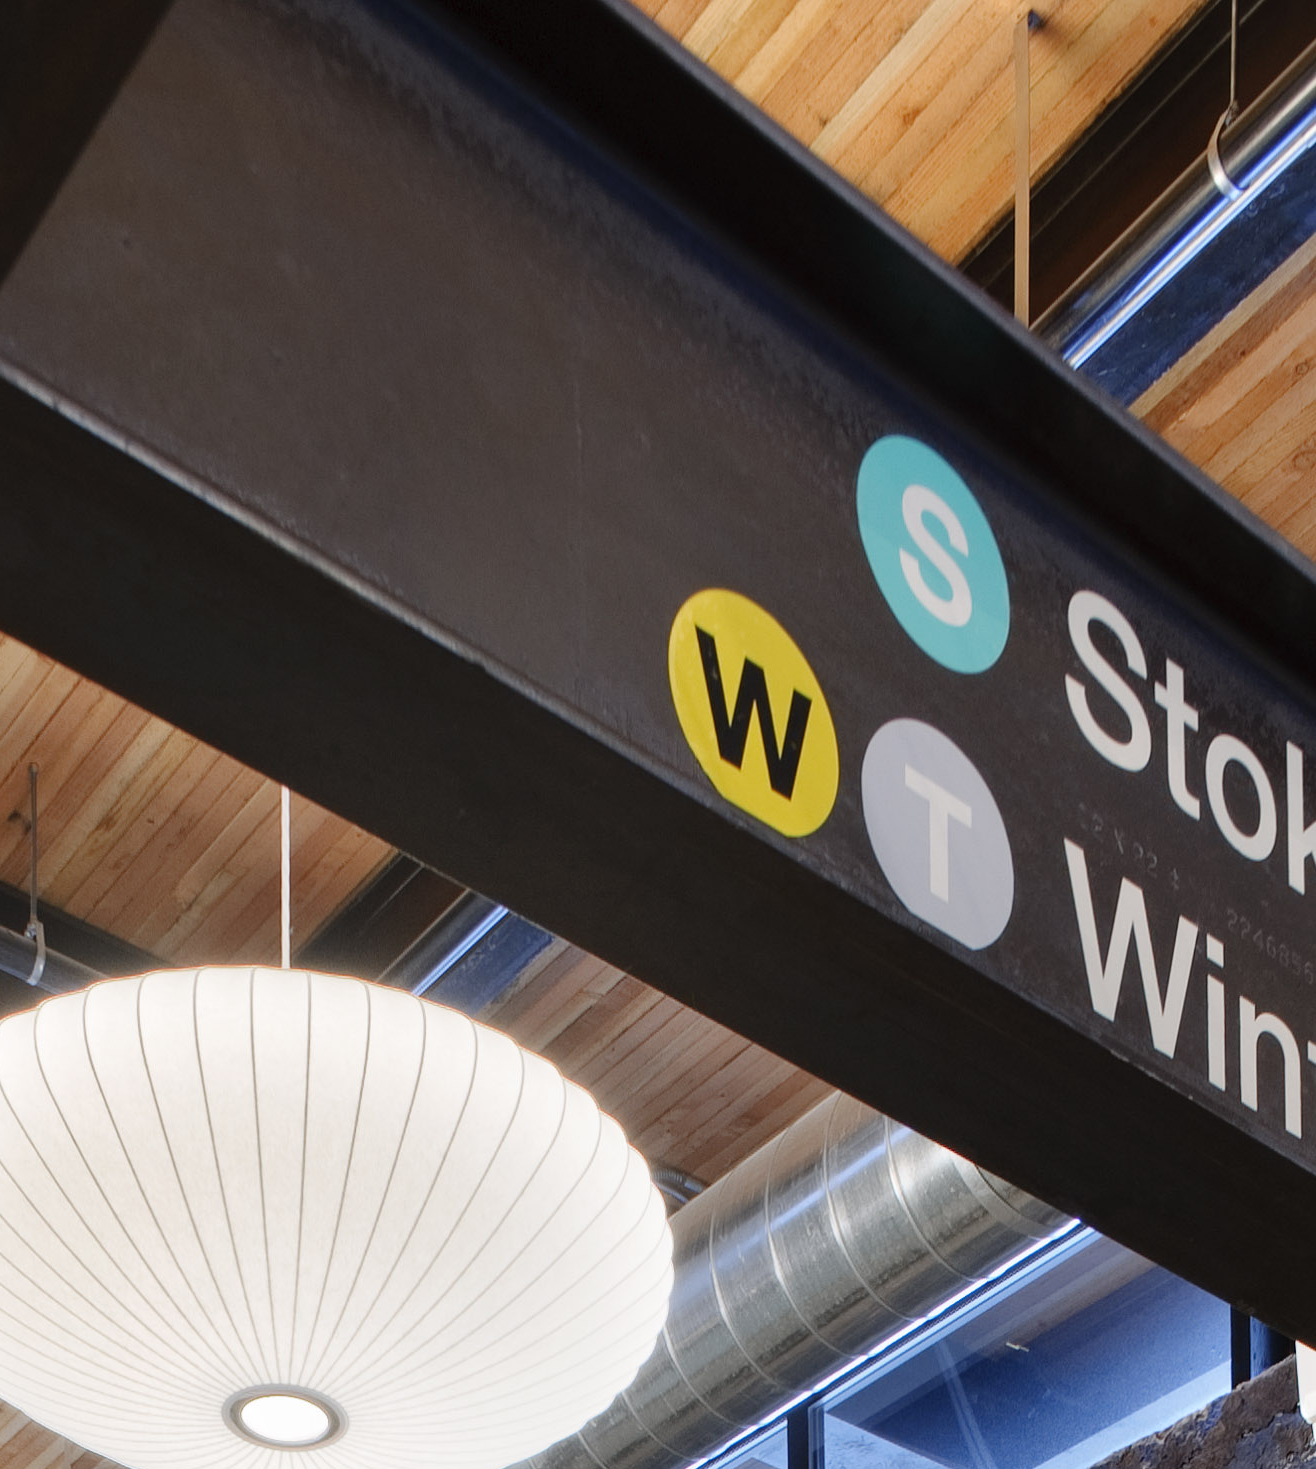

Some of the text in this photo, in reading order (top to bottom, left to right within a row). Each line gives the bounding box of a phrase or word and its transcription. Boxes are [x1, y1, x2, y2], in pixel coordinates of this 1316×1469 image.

[899, 484, 972, 628] S
[694, 624, 813, 801] W
[904, 762, 973, 904] T
